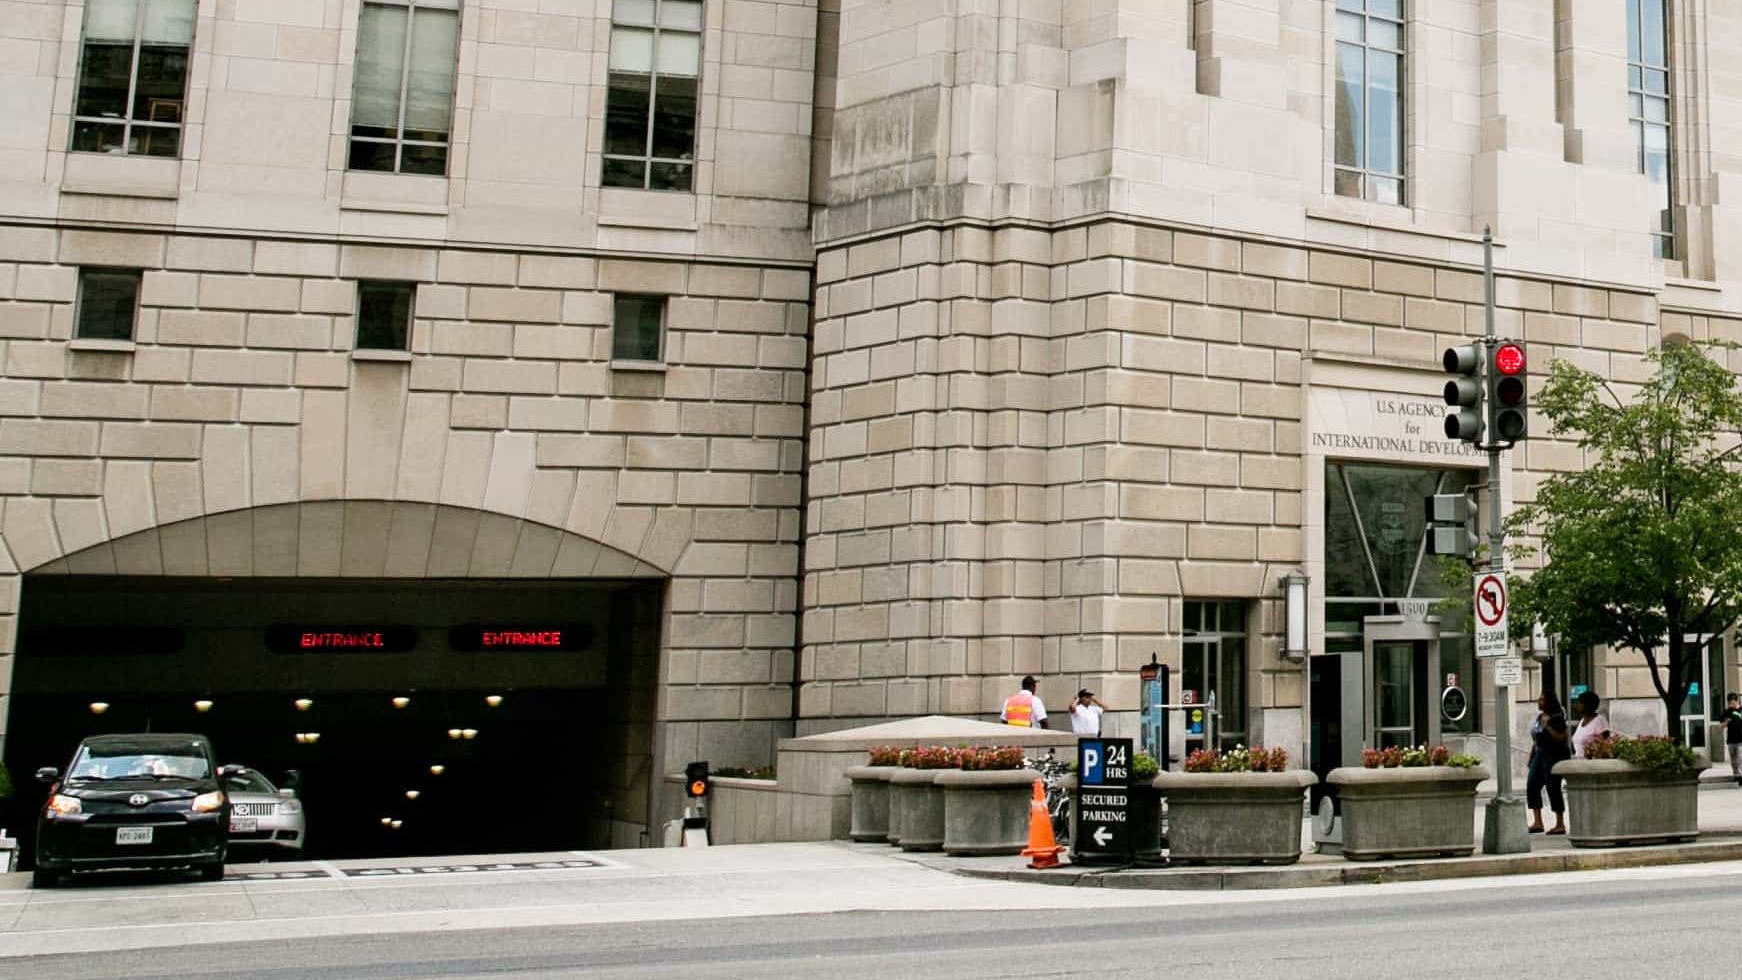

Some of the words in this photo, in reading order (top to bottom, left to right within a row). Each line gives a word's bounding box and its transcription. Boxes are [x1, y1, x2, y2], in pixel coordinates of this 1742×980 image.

[1399, 403, 1447, 418] AGENCY
[1405, 422, 1421, 434] for
[1312, 433, 1415, 453] INTERNATIONAL
[301, 633, 384, 647] ENTRANCE
[482, 632, 561, 645] ENTRANCE
[1107, 745, 1126, 765] 24
[1084, 749, 1098, 777] P
[1106, 767, 1128, 778] HRS
[1081, 794, 1128, 806] SECURED
[1082, 810, 1126, 822] PARKING
